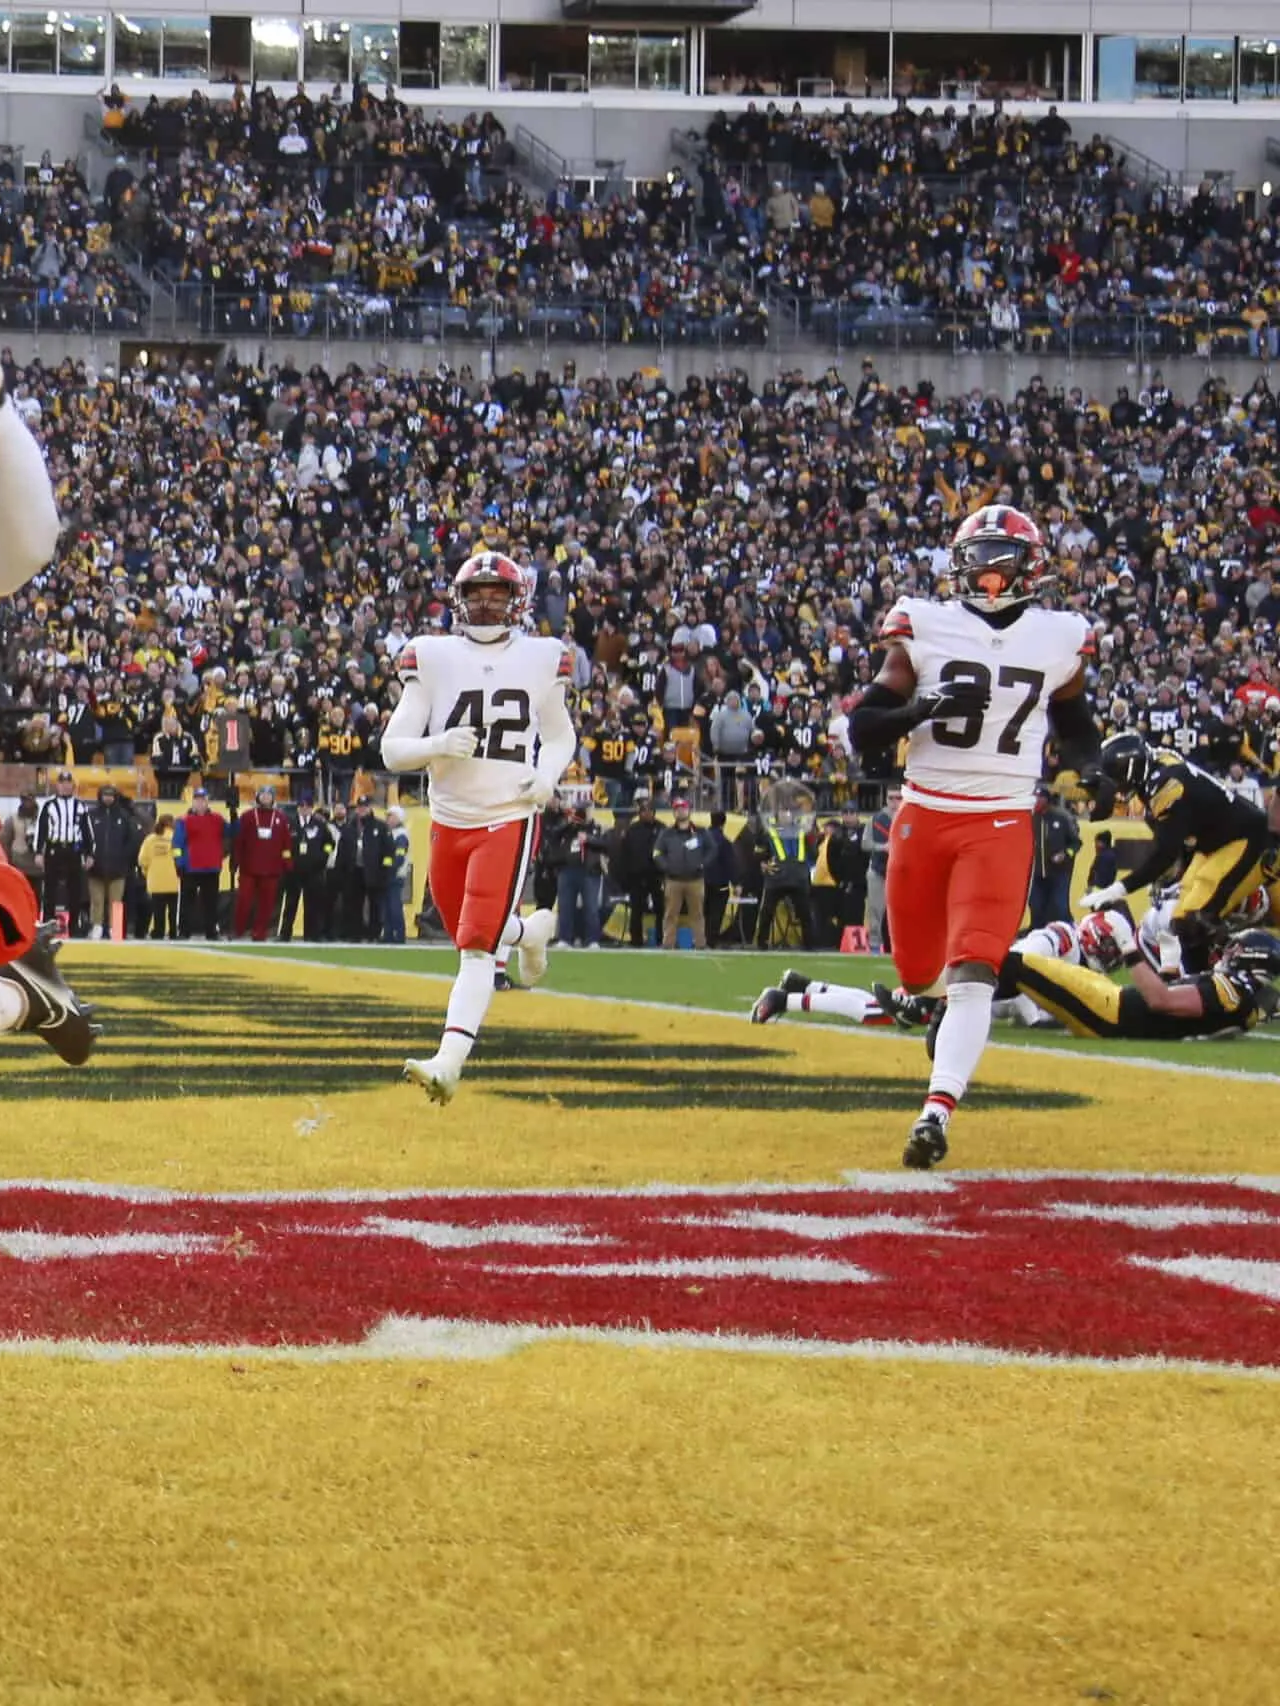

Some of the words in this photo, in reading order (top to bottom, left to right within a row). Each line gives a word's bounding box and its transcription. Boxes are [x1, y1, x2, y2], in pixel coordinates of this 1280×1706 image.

[932, 660, 1045, 756] 37
[226, 719, 240, 750] 1
[445, 689, 530, 763] 42
[329, 735, 352, 755] 90
[602, 741, 624, 761] 90
